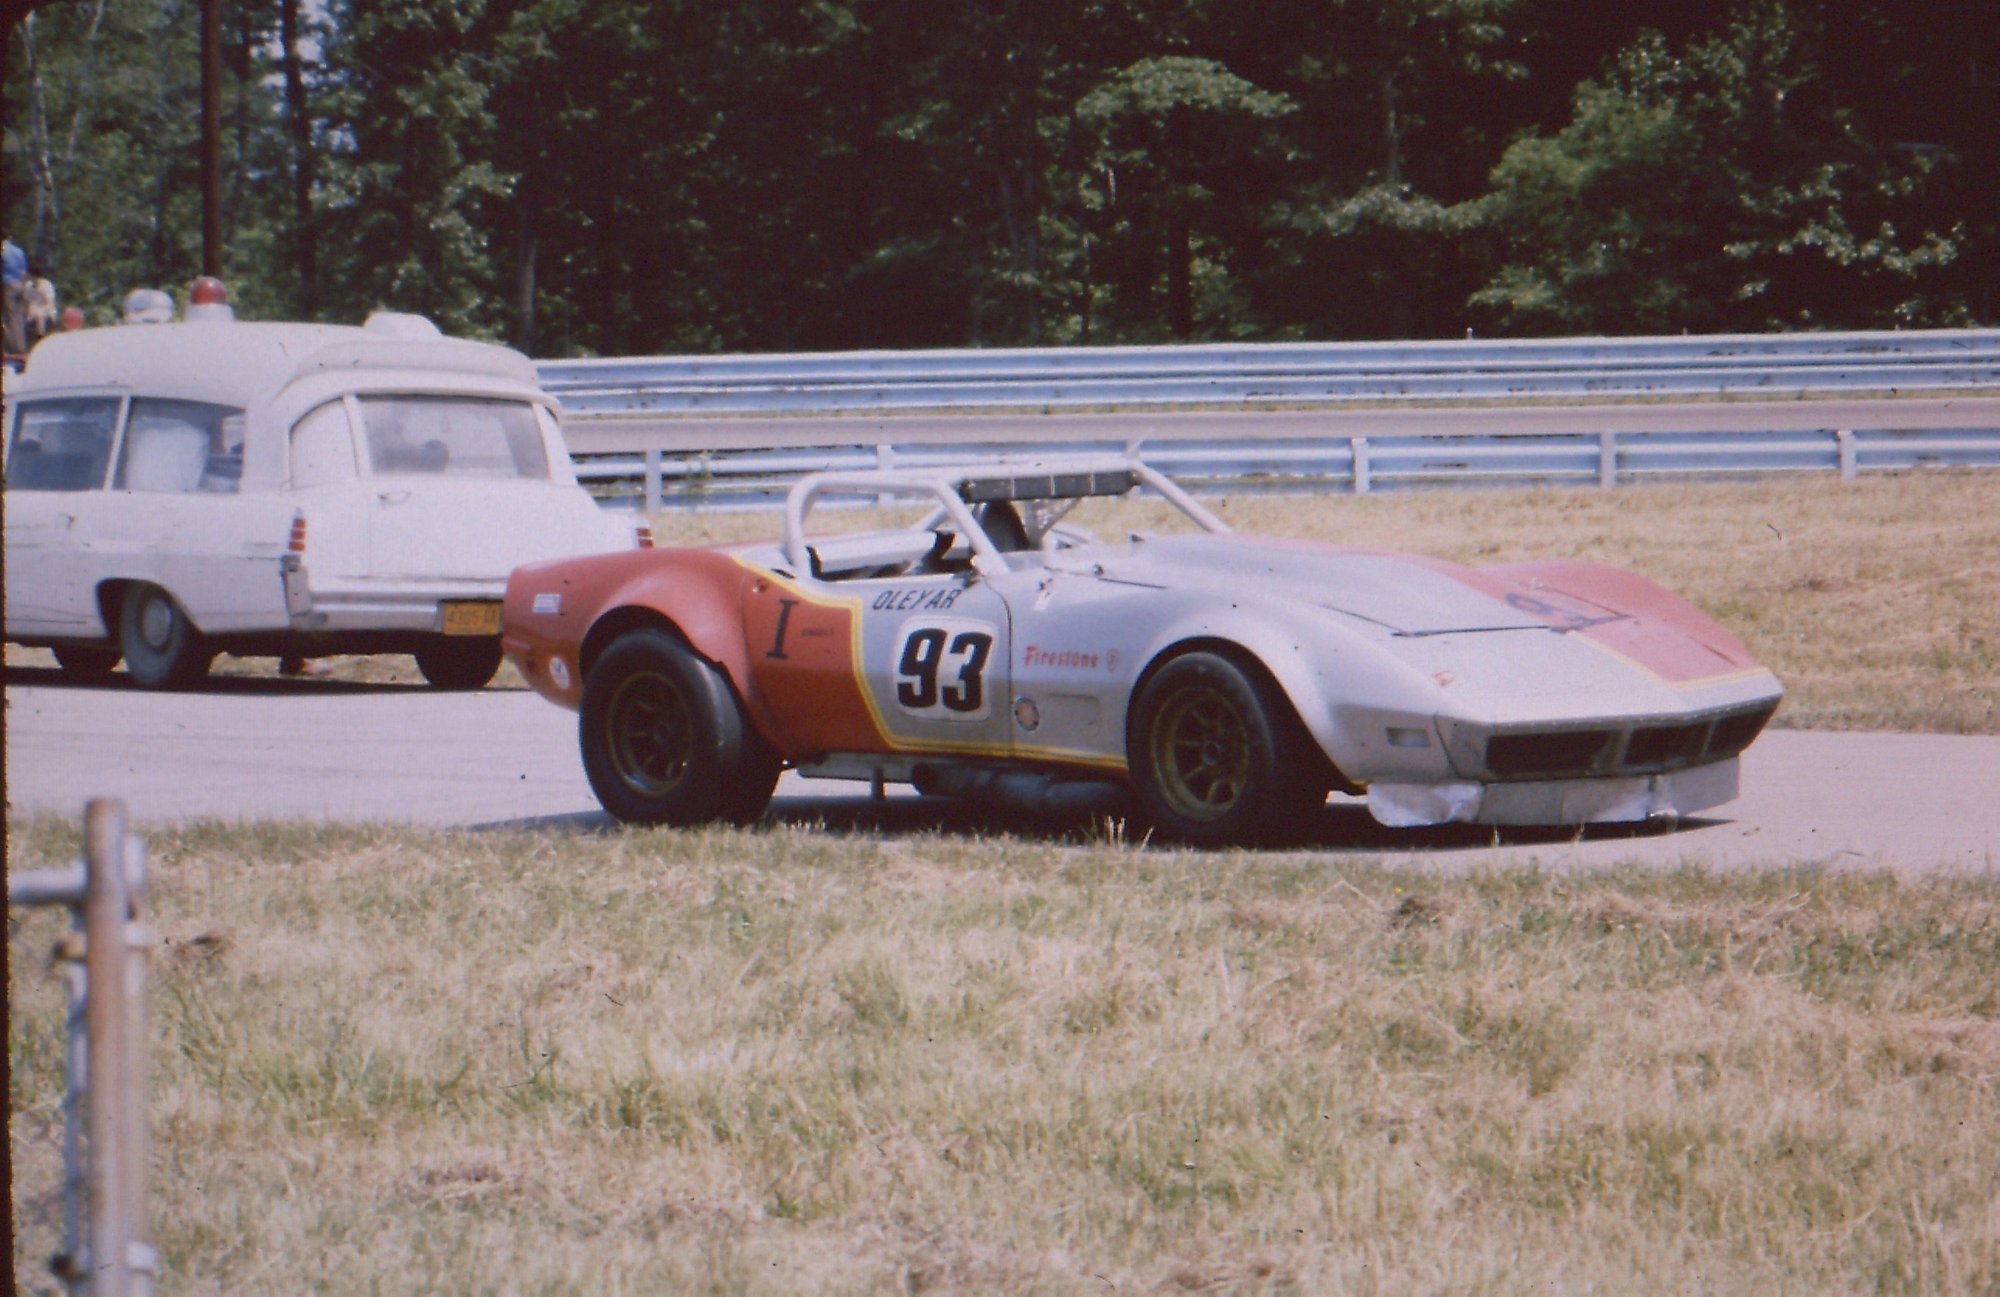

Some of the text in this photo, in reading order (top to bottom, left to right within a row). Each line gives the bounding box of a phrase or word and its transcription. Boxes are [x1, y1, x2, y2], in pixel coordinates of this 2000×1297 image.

[872, 588, 962, 610] OLEYAR
[1023, 645, 1099, 669] Firestone
[896, 627, 993, 713] 93
